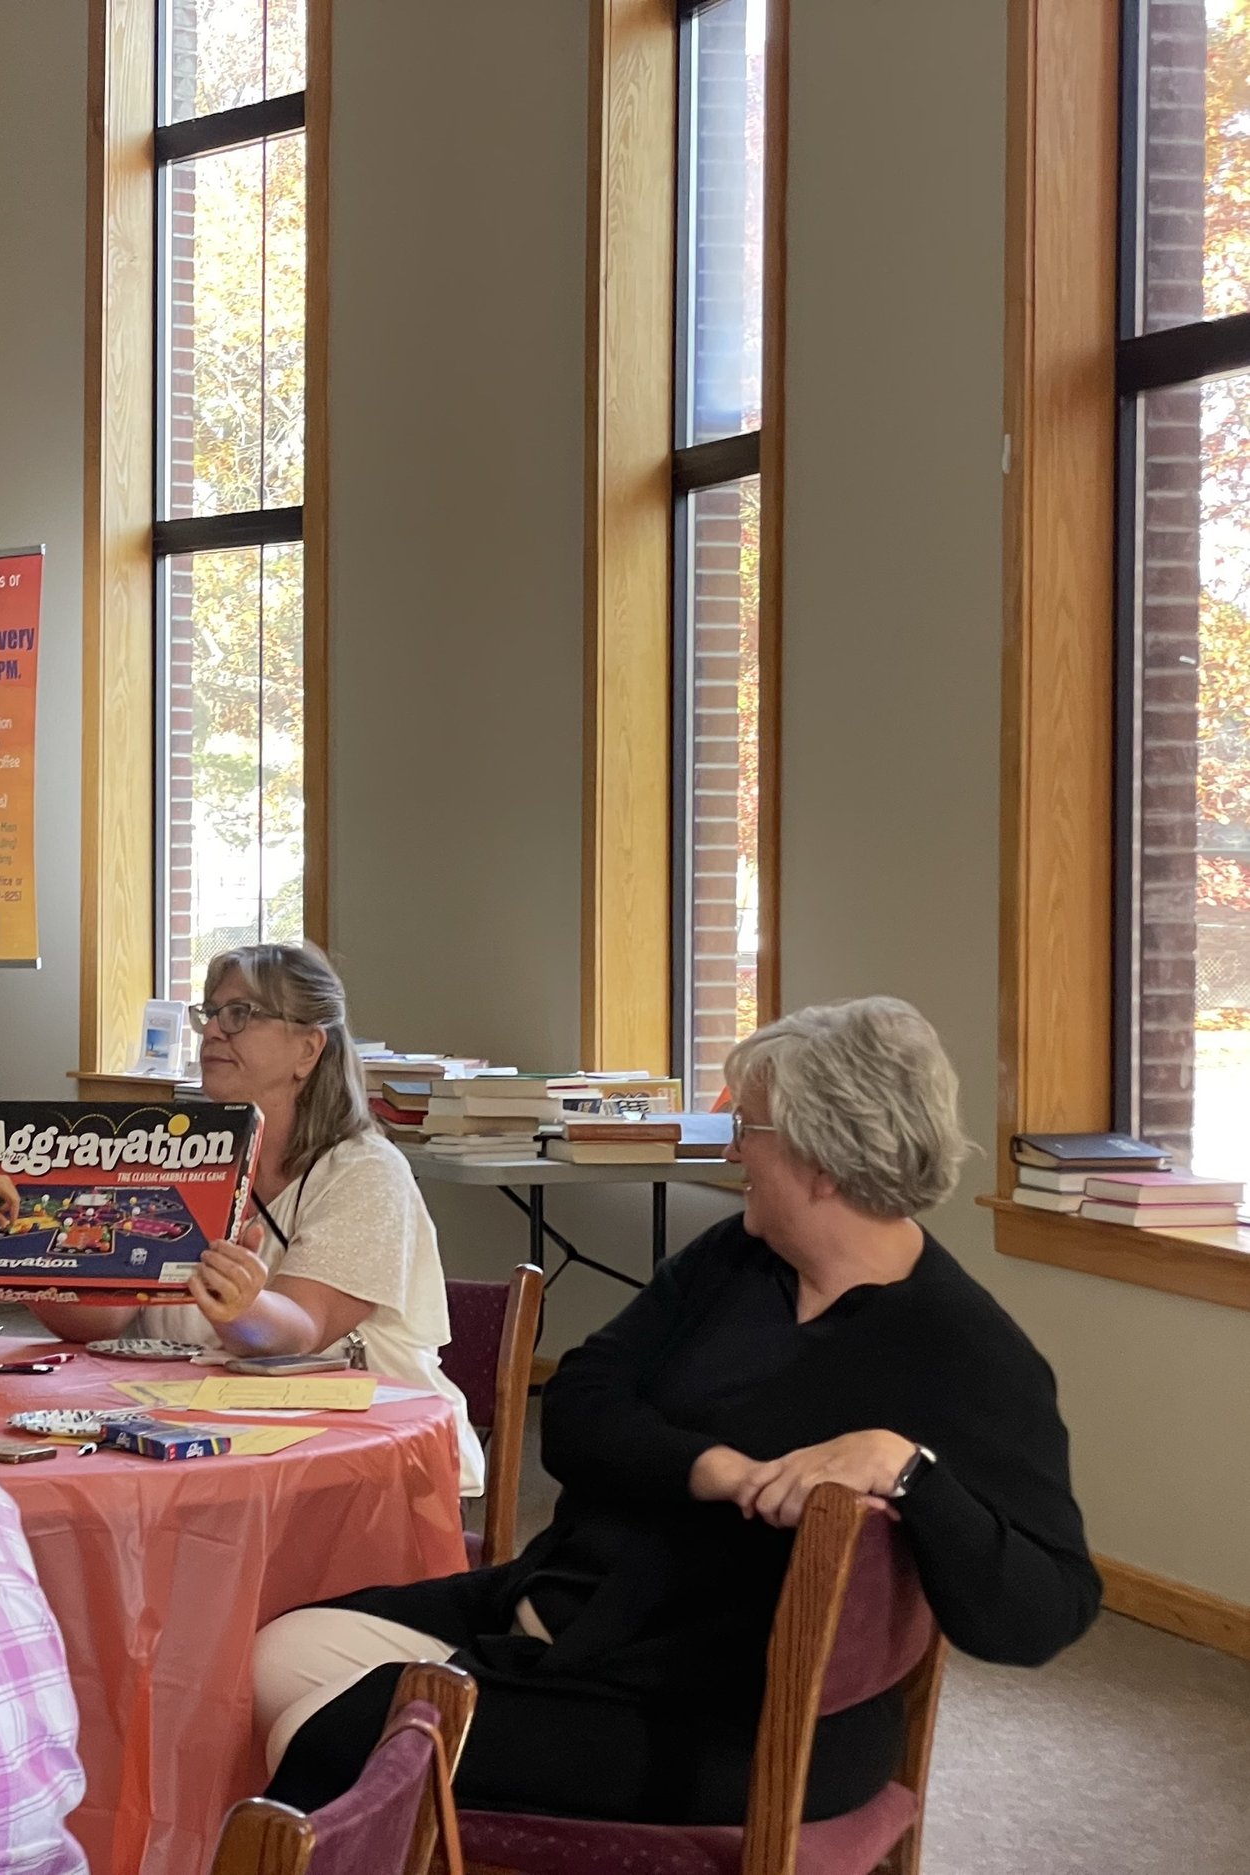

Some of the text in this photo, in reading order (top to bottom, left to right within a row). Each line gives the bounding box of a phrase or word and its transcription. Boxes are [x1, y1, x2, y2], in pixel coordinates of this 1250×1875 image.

[9, 574, 21, 586] or
[117, 1171, 227, 1182] THE CLASSIC MARBLE RACE GAME
